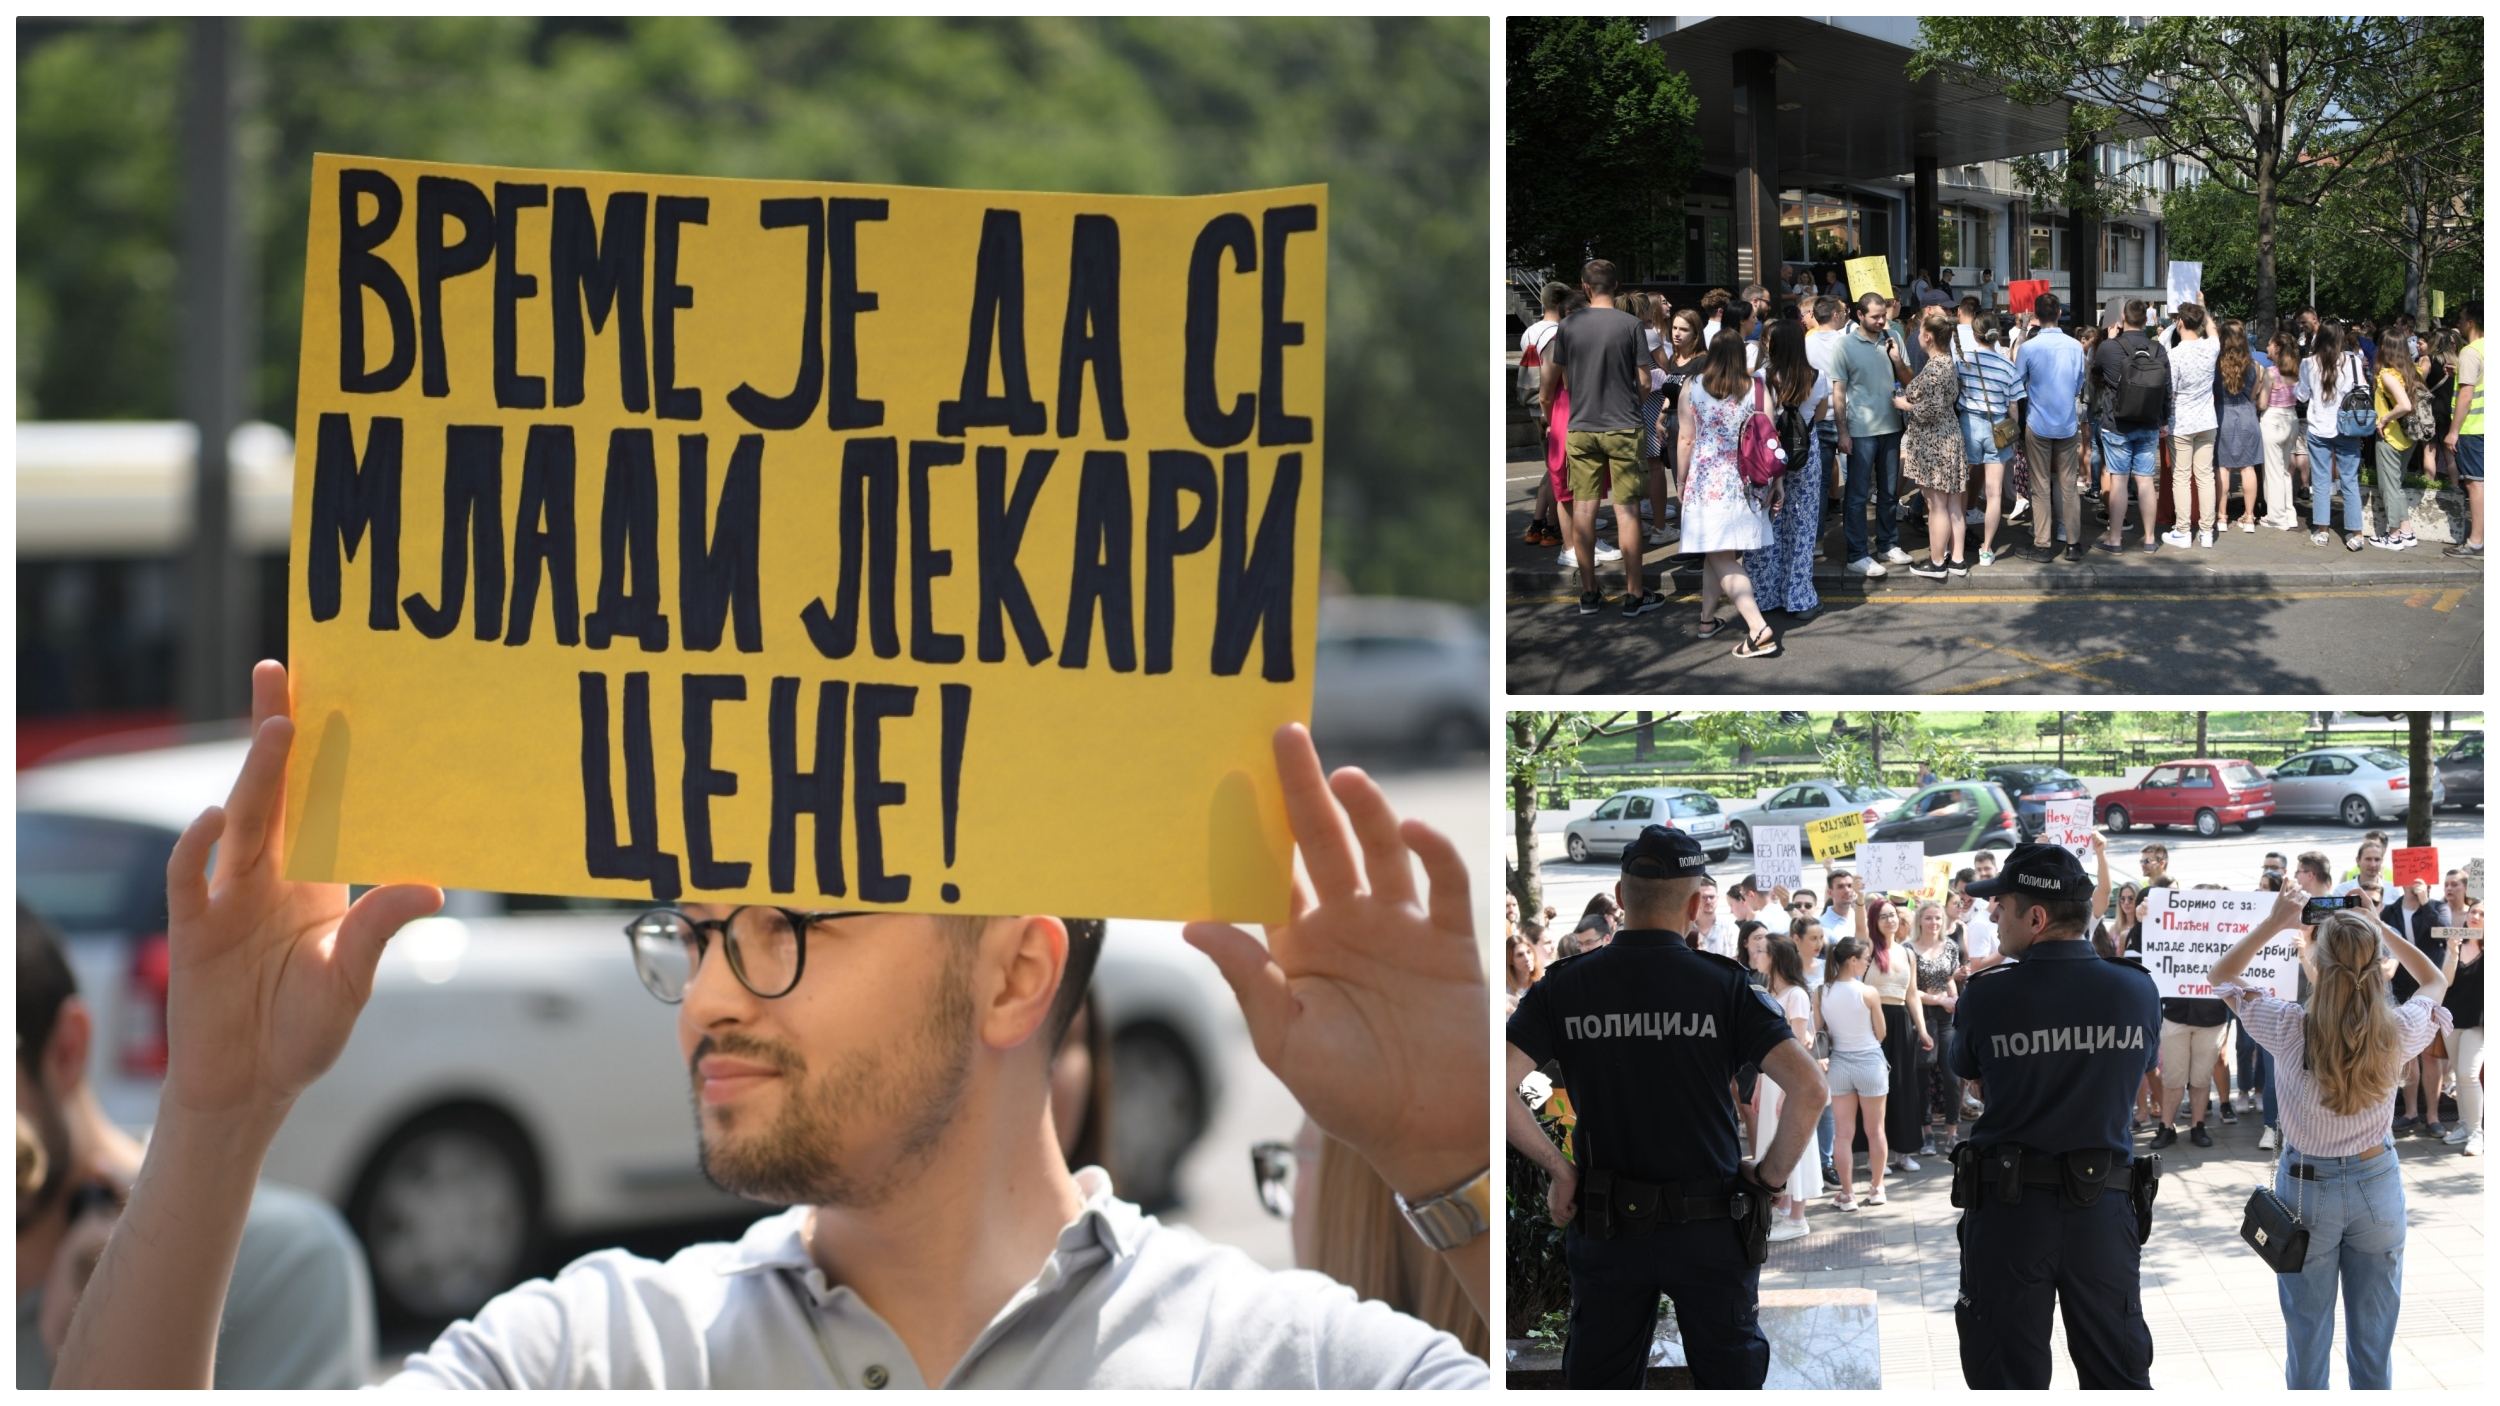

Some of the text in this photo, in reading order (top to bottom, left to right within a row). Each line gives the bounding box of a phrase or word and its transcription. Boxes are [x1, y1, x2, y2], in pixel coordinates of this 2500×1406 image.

[339, 168, 1317, 449] ВРЕМЕ ЈЕ ДА СЕ
[308, 412, 1302, 683] МЛАДИ ЛЕКАРИ
[578, 671, 971, 903] ЦЕНЕ!
[1761, 828, 1791, 842] СТАЖ
[1757, 843, 1797, 858] БЕЗ ПАРА
[1757, 875, 1772, 888] БЕЗ
[2018, 873, 2061, 890] ПОЛИЦИЈА
[2168, 891, 2257, 912] Боримо се за:
[2163, 911, 2250, 933] Плаћен стаж
[2146, 941, 2185, 952] младе
[2162, 955, 2212, 978] Правед
[1565, 1012, 1718, 1040] ПОЛИЦИЈА
[1991, 1025, 2144, 1058] ПОЛИЦИЈА
